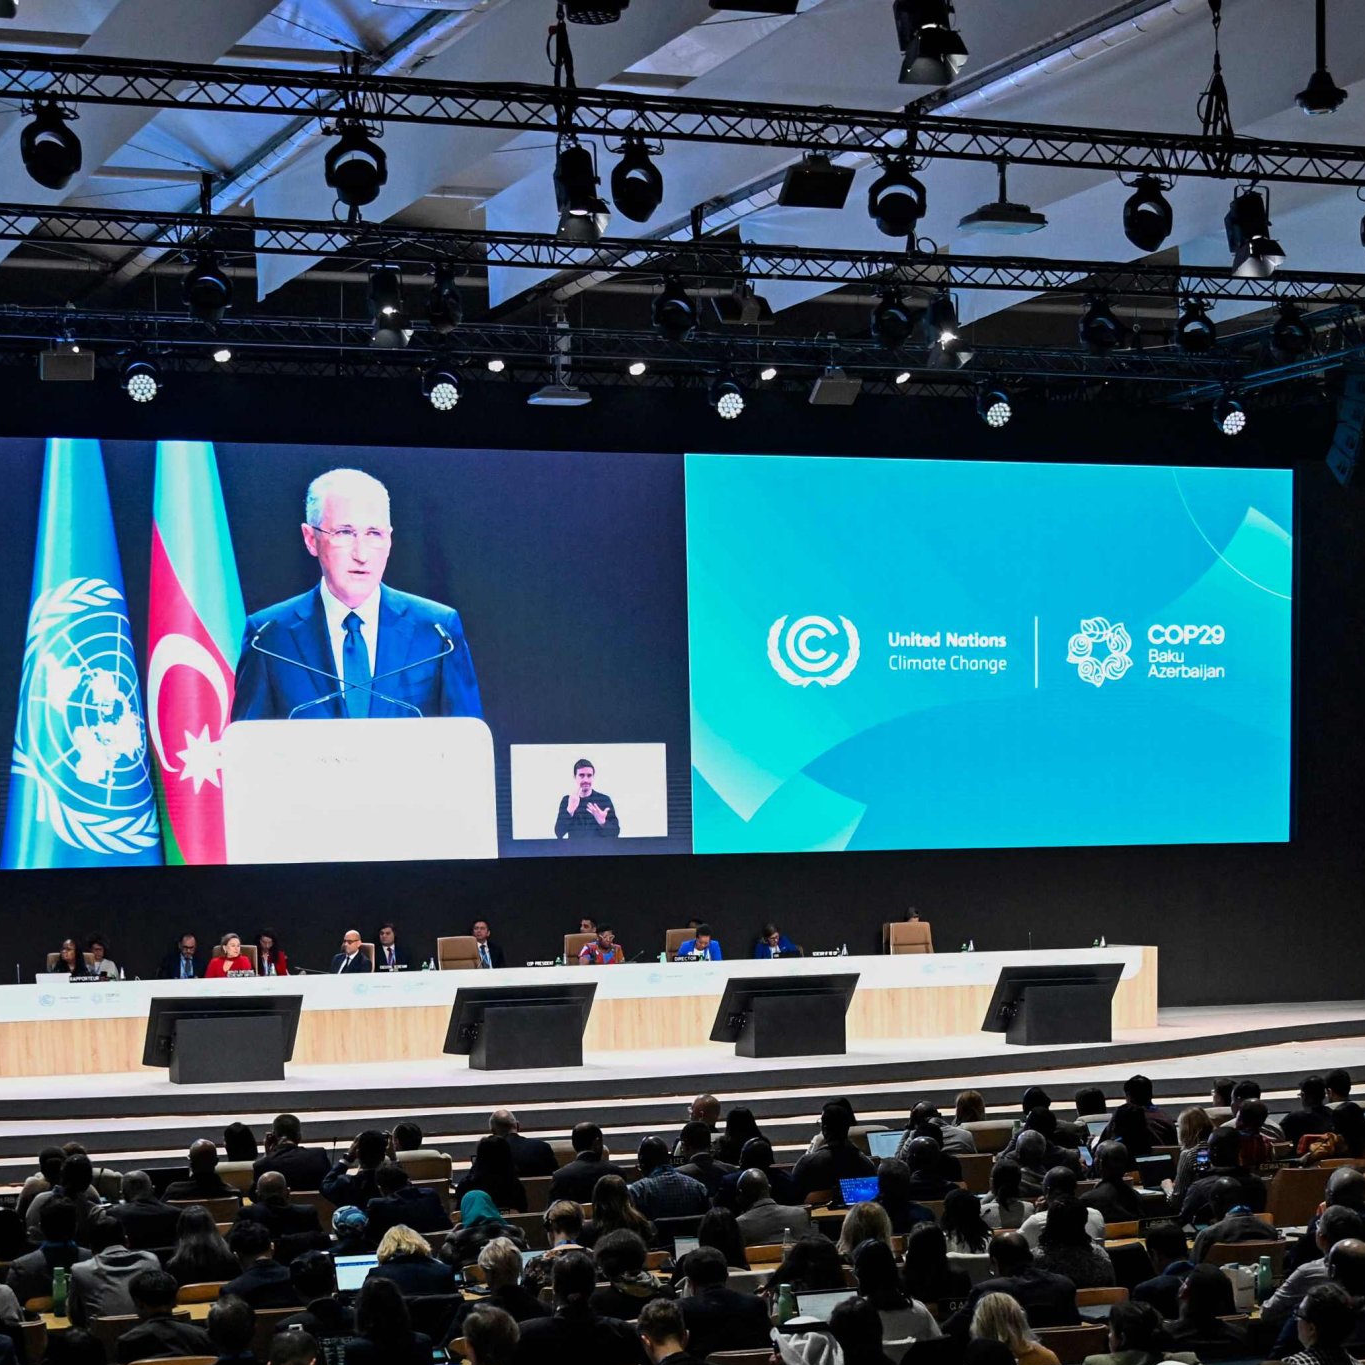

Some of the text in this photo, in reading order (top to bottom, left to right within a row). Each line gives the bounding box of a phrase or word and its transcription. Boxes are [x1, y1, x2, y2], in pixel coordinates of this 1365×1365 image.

[888, 631, 1007, 648] United Nations
[1148, 625, 1226, 645] COP29
[1148, 648, 1185, 663] Baku
[889, 655, 1007, 675] Climate Change
[1148, 663, 1225, 681] Azerbaijan
